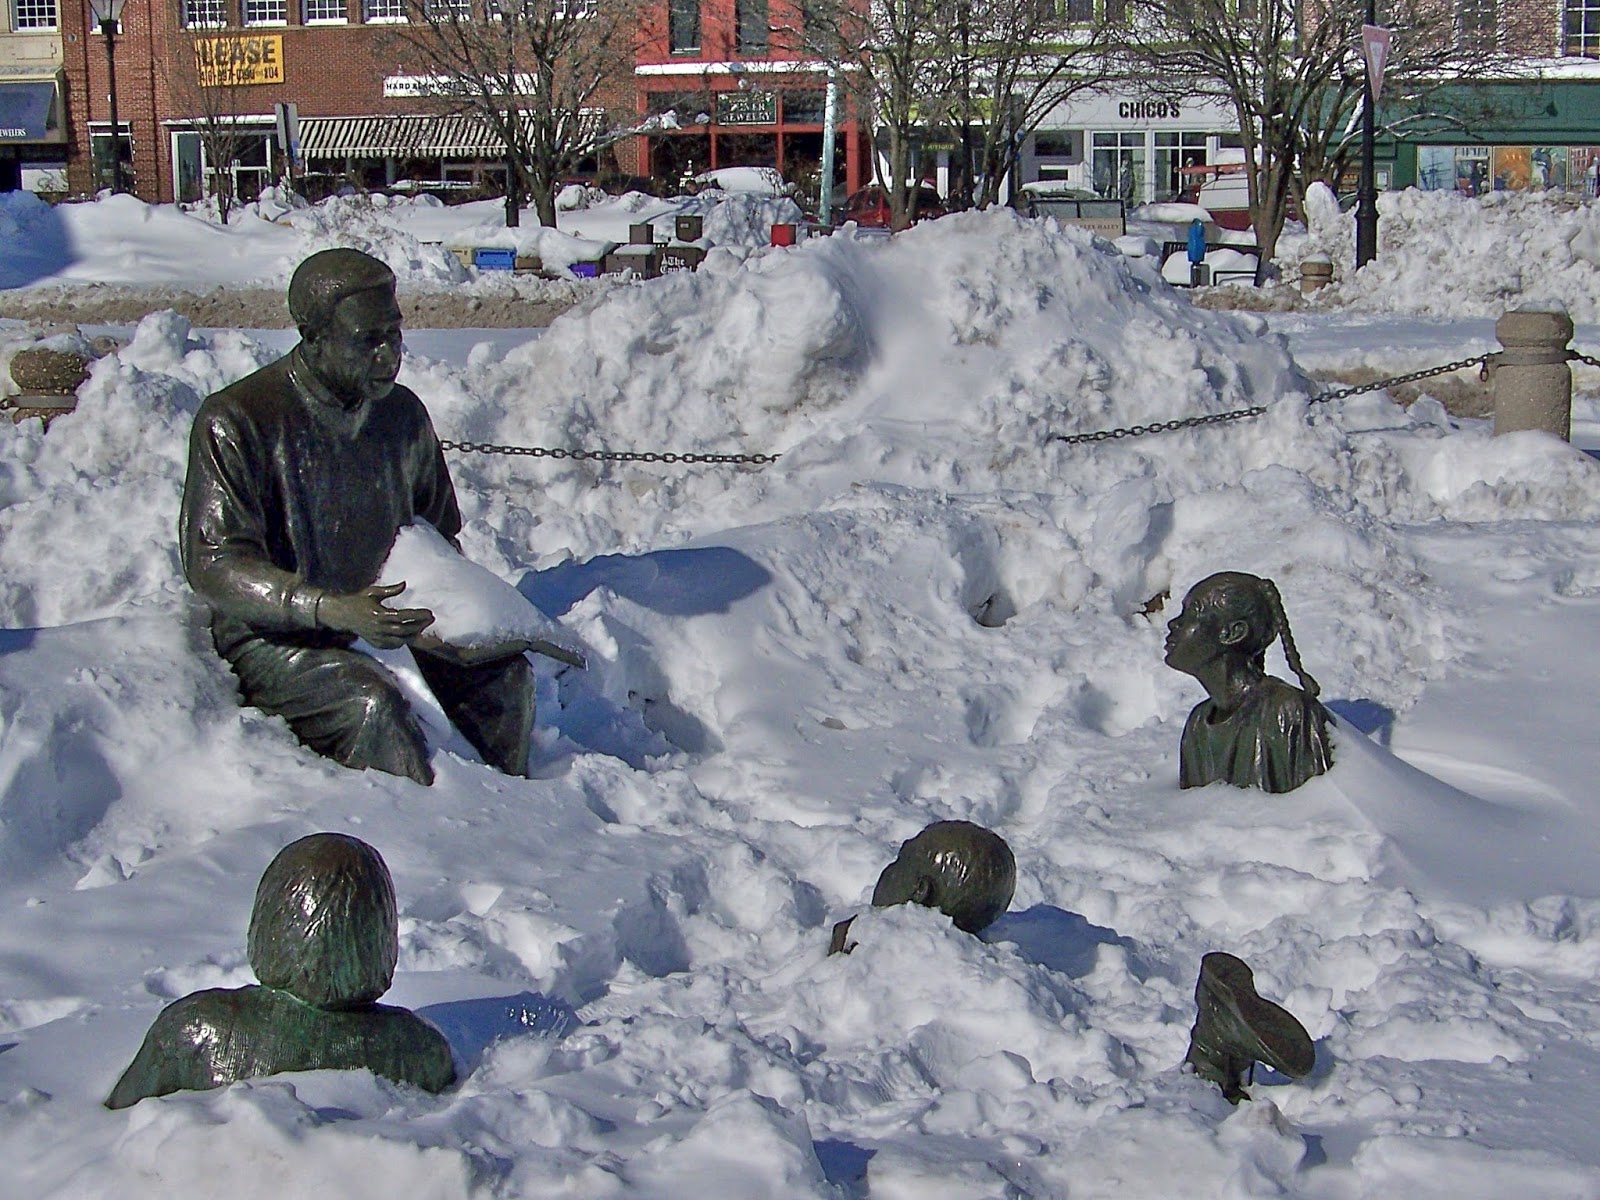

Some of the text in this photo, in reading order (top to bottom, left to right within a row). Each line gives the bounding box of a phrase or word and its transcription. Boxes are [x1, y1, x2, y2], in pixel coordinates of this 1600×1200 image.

[200, 38, 276, 66] LEASE
[386, 82, 411, 90] HARD
[667, 256, 685, 266] The
